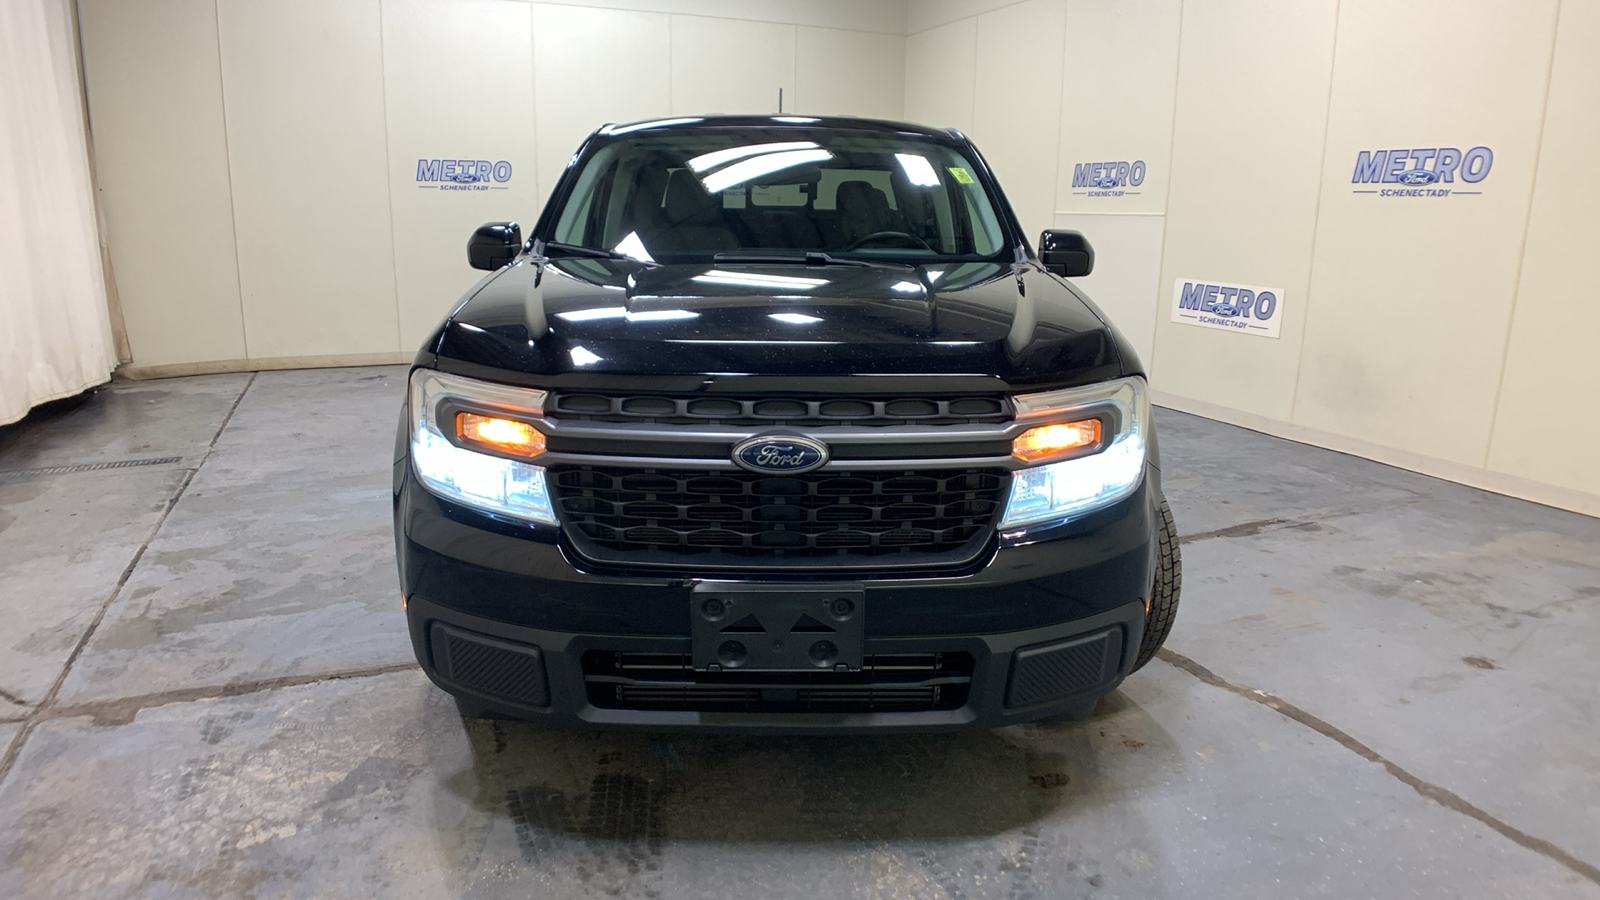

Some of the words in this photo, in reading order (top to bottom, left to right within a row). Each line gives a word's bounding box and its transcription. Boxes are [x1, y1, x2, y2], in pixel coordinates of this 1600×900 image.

[416, 159, 512, 183] METRO
[1071, 160, 1146, 188] METRO
[1351, 146, 1494, 183] METRO
[1379, 188, 1452, 198] SCHENECTADY
[1178, 282, 1278, 321] METRO
[1198, 316, 1248, 329] SCHENECTADY
[756, 445, 805, 466] Ford
